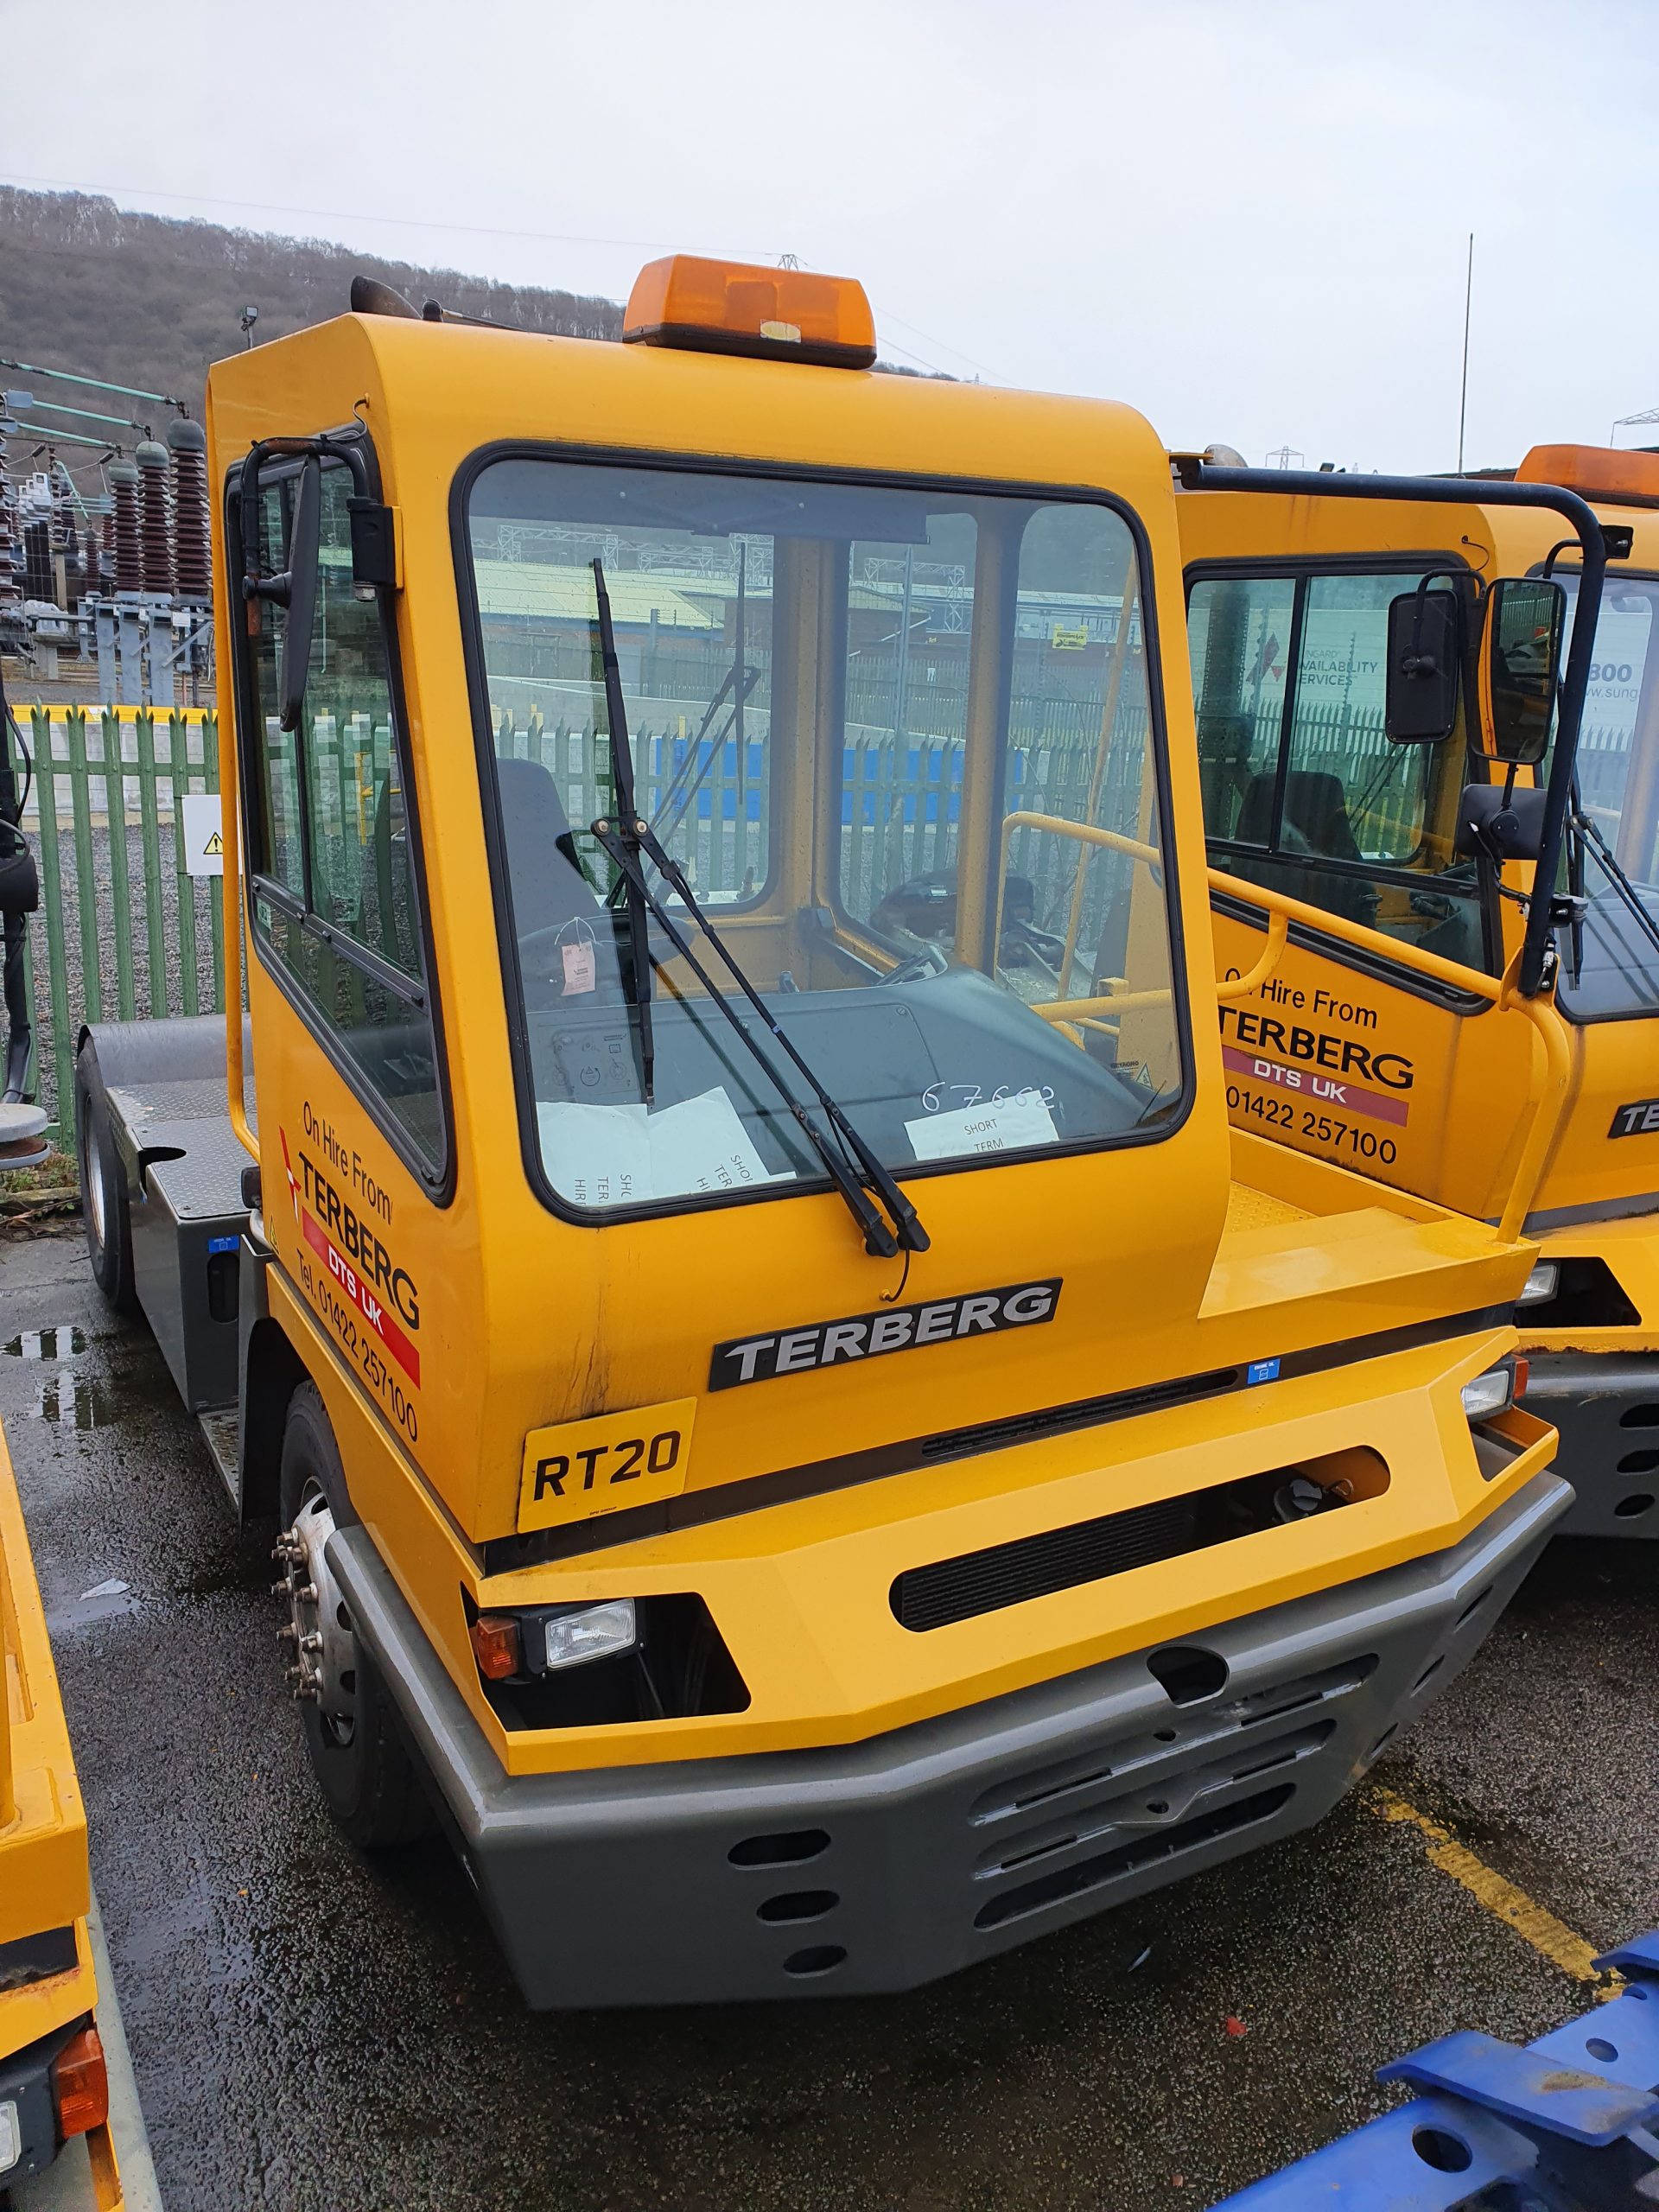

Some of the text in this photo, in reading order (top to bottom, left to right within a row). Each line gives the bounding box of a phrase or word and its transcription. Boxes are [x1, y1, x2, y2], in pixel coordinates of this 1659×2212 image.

[1300, 660, 1378, 673] VAILABILITY
[1300, 673, 1353, 686] ERVICES
[1261, 978, 1306, 1009] Hire
[1313, 989, 1378, 1029] From
[1217, 1004, 1414, 1090] TERBERG
[1254, 1058, 1348, 1104] DTS UK
[963, 1118, 998, 1136] SHORT
[974, 1137, 1005, 1153] TERM
[1225, 1085, 1397, 1165] 01422 257100
[303, 1101, 393, 1226] On Hire From
[596, 1176, 610, 1203] TER
[714, 1163, 734, 1188] TER
[298, 1150, 420, 1331] TERBERG
[327, 1243, 385, 1336] DTS UK
[296, 1247, 418, 1443] Tel. 01422 257100
[724, 1286, 1054, 1382] TERBERG
[533, 1430, 682, 1502] RT20
